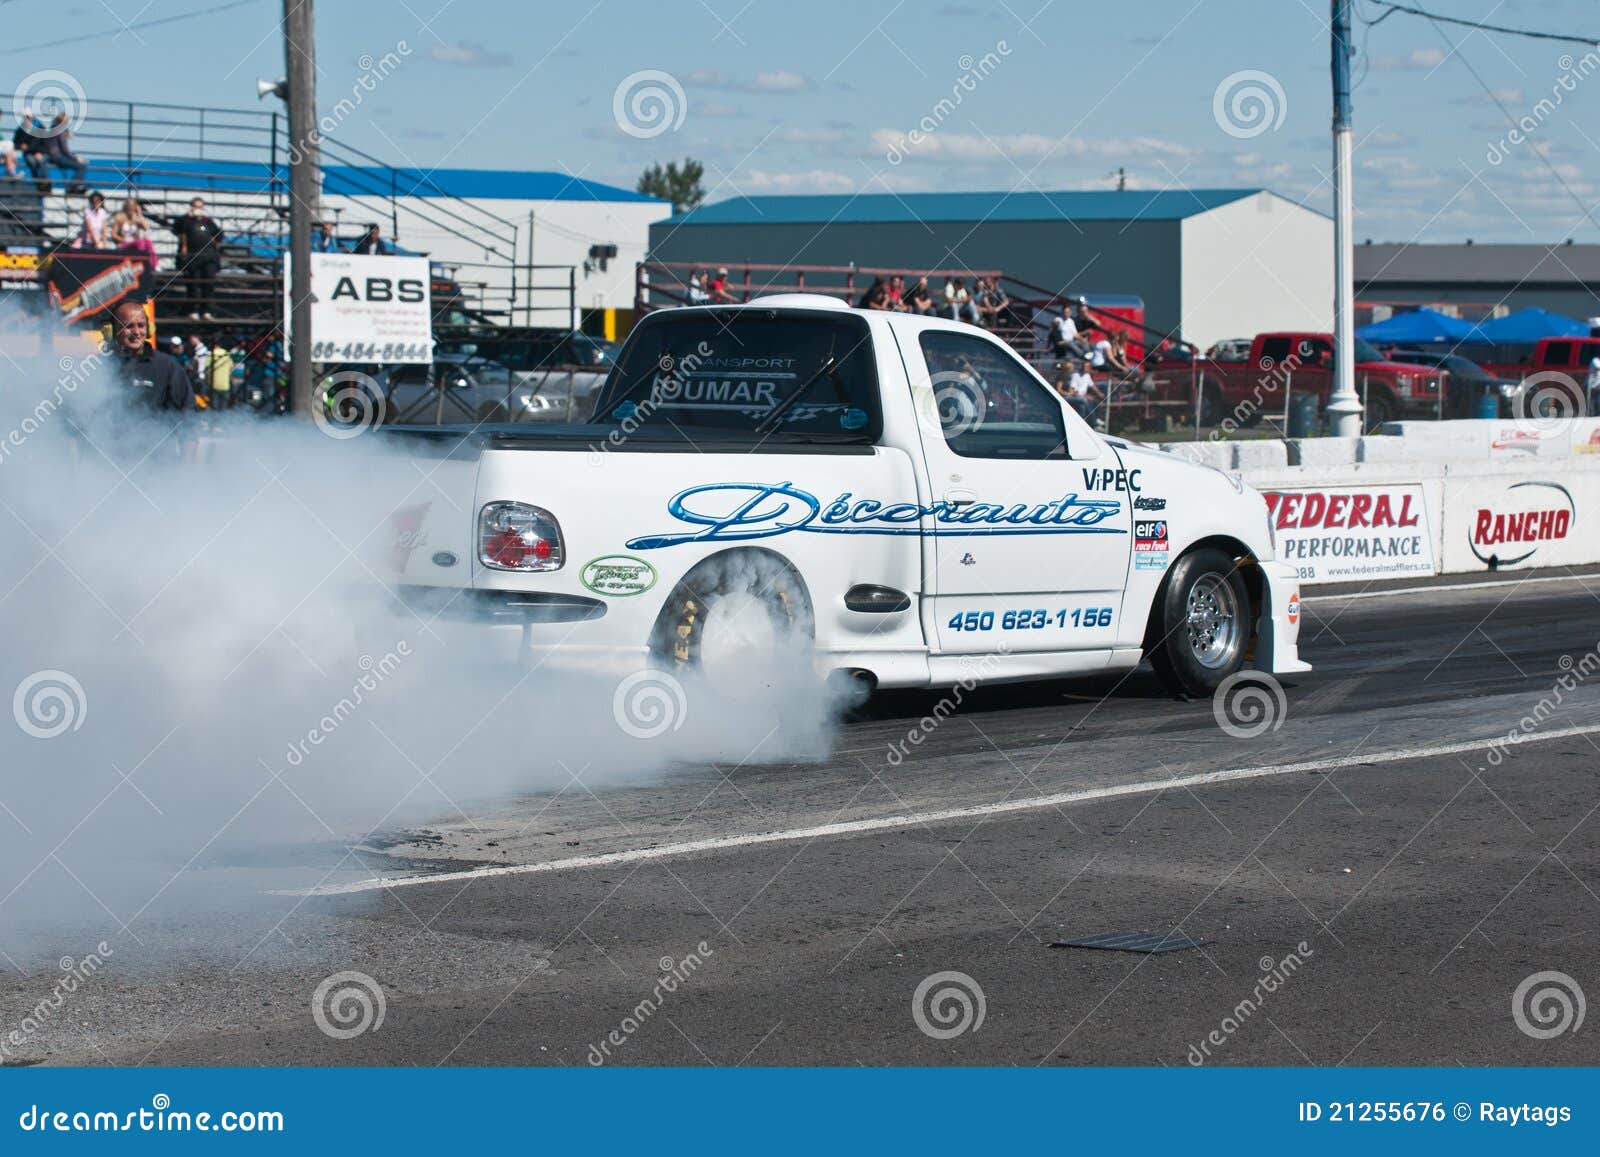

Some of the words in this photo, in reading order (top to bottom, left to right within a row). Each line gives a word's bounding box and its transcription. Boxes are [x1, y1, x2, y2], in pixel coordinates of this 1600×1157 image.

[331, 276, 425, 303] ABS
[1136, 523, 1156, 537] elf
[1474, 508, 1570, 545] RANCHO
[1284, 535, 1422, 559] PERFORMANCE
[948, 611, 995, 632] 450
[1001, 607, 1113, 631] 623-1156
